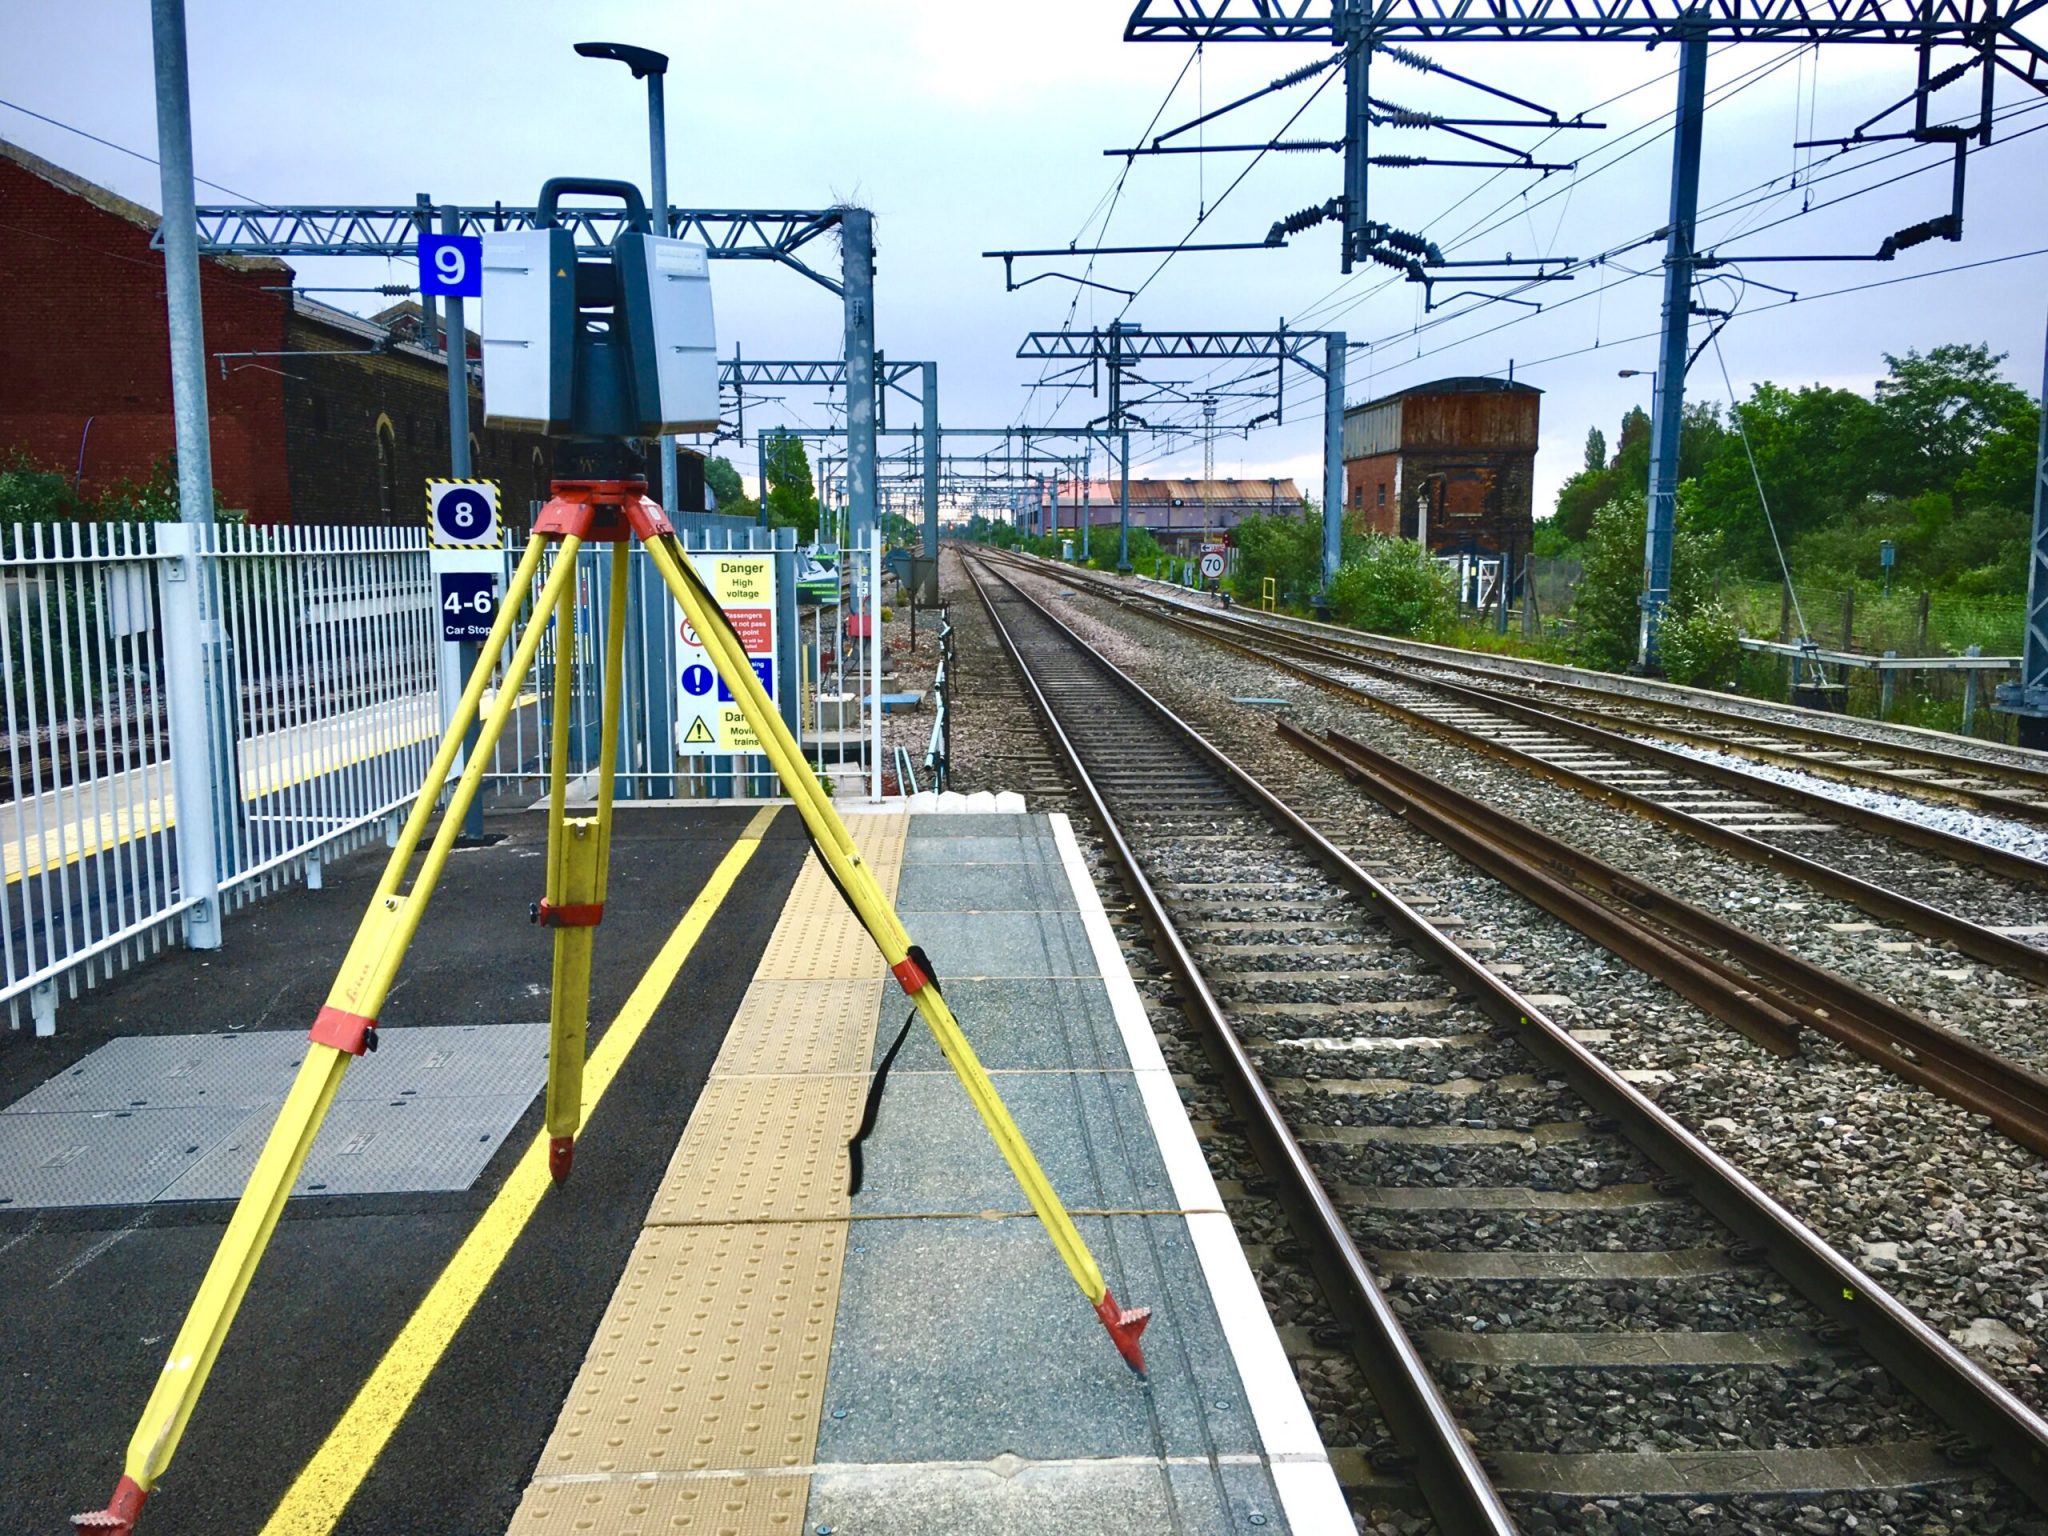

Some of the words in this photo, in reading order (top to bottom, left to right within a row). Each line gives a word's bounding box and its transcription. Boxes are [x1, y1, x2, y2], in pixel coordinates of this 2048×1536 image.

[434, 245, 466, 285] 9
[454, 502, 474, 527] 8
[721, 562, 764, 575] Danger
[1205, 559, 1221, 571] 70
[732, 579, 753, 588] High
[727, 590, 759, 599] voltage
[444, 591, 492, 615] 4-6
[446, 625, 465, 635] Car
[467, 625, 492, 636] Stop
[734, 737, 760, 746] trains
